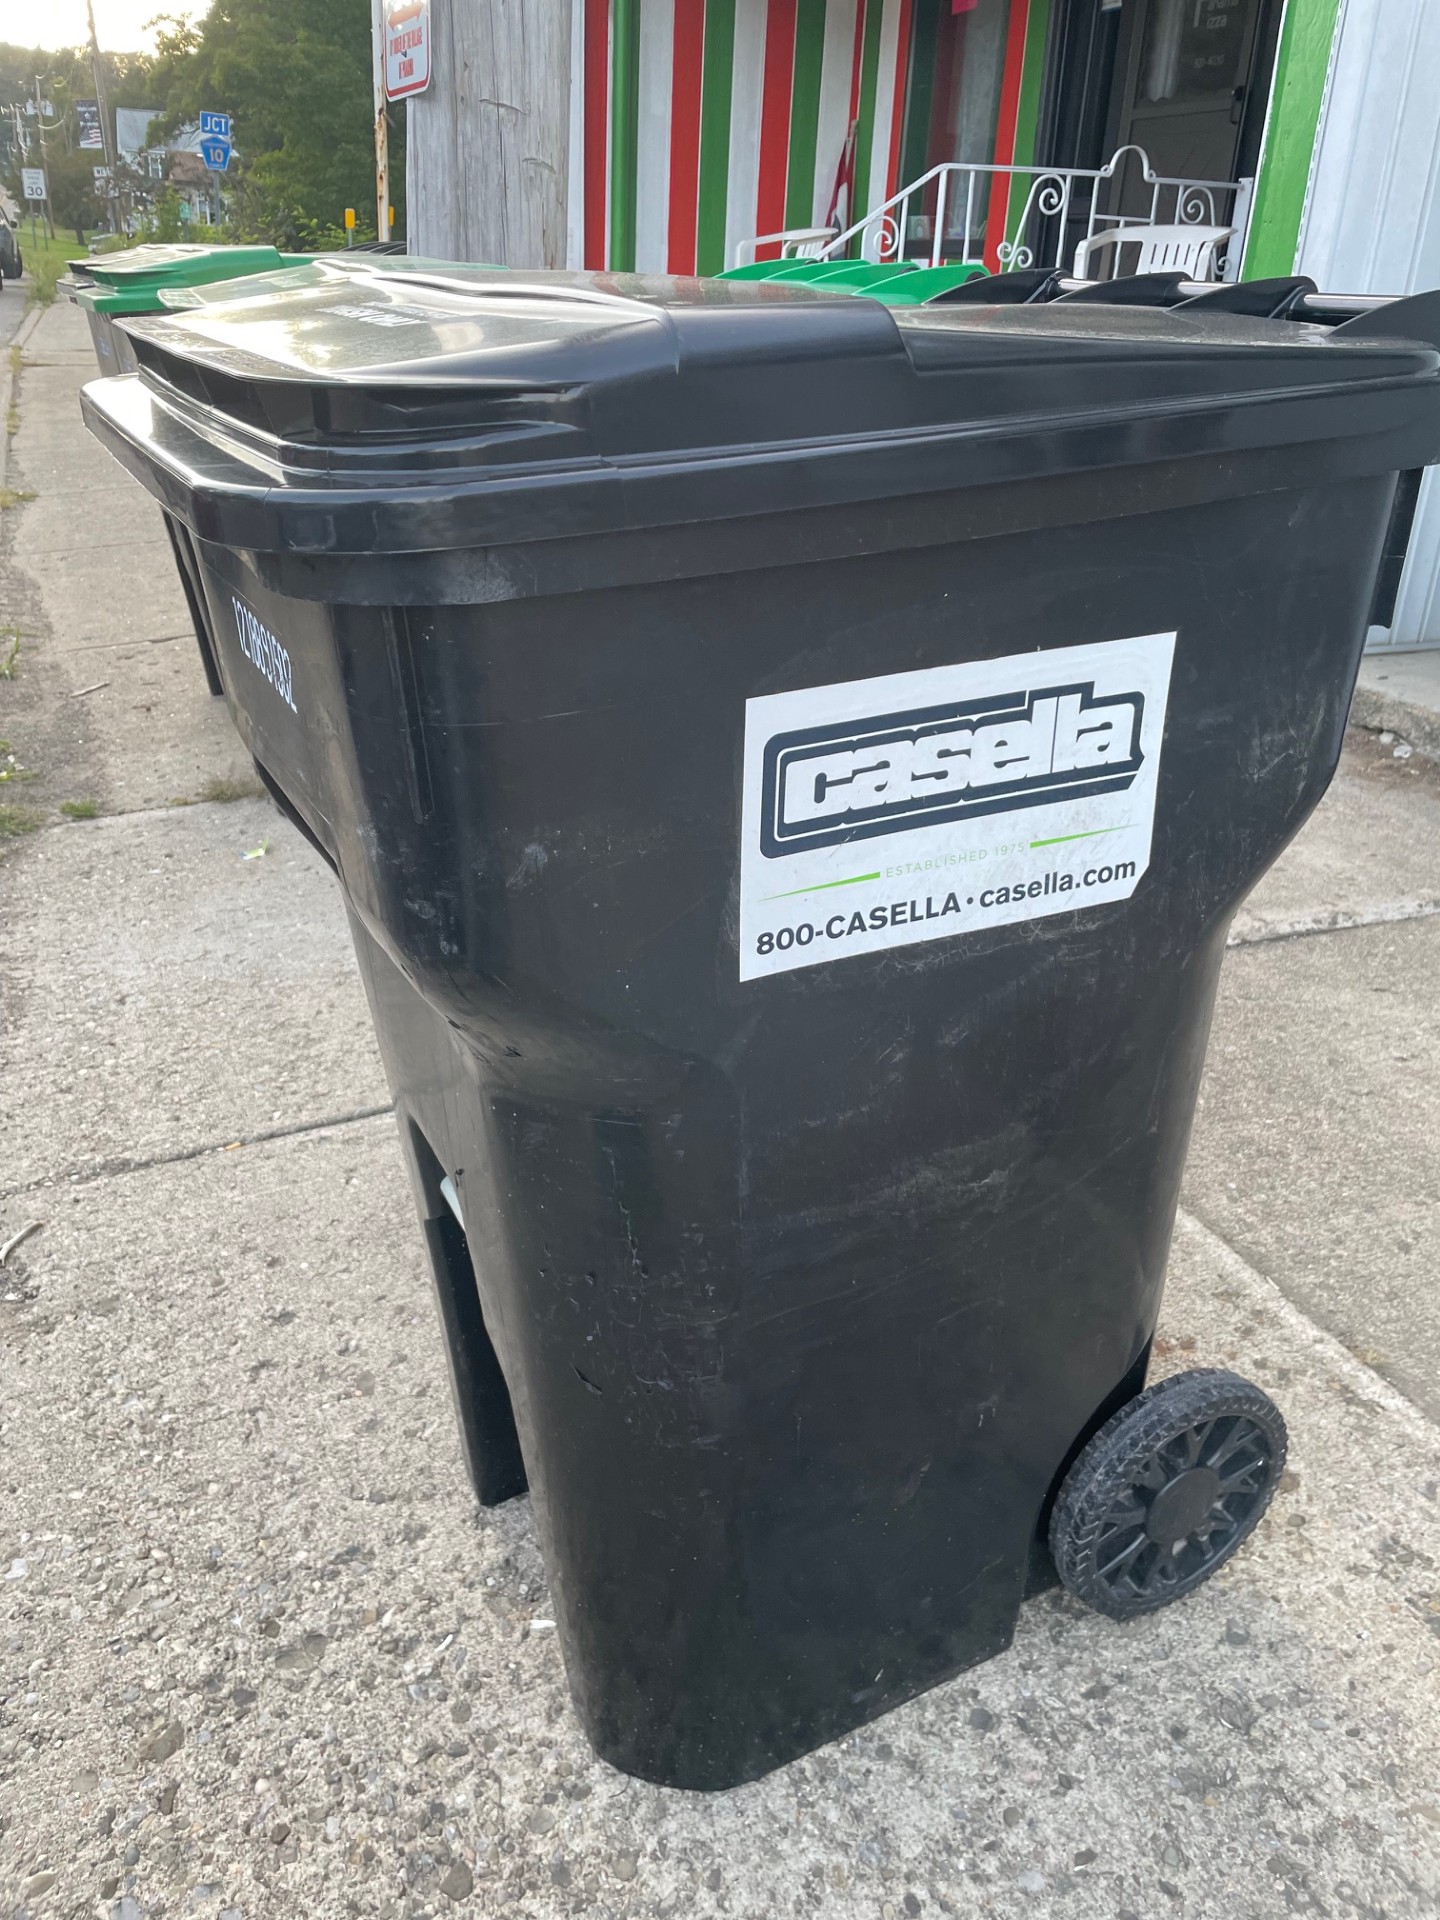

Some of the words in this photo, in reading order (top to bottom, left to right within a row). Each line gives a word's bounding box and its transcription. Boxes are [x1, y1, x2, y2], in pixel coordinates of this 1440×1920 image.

[203, 116, 226, 133] JCT
[209, 147, 225, 163] 10
[27, 186, 43, 197] 30
[783, 691, 1135, 826] casella
[885, 849, 989, 879] ESTABLISHED
[994, 841, 1026, 857] 1975
[756, 892, 961, 956] 800-CASELLA
[979, 860, 1136, 907] casella.com
